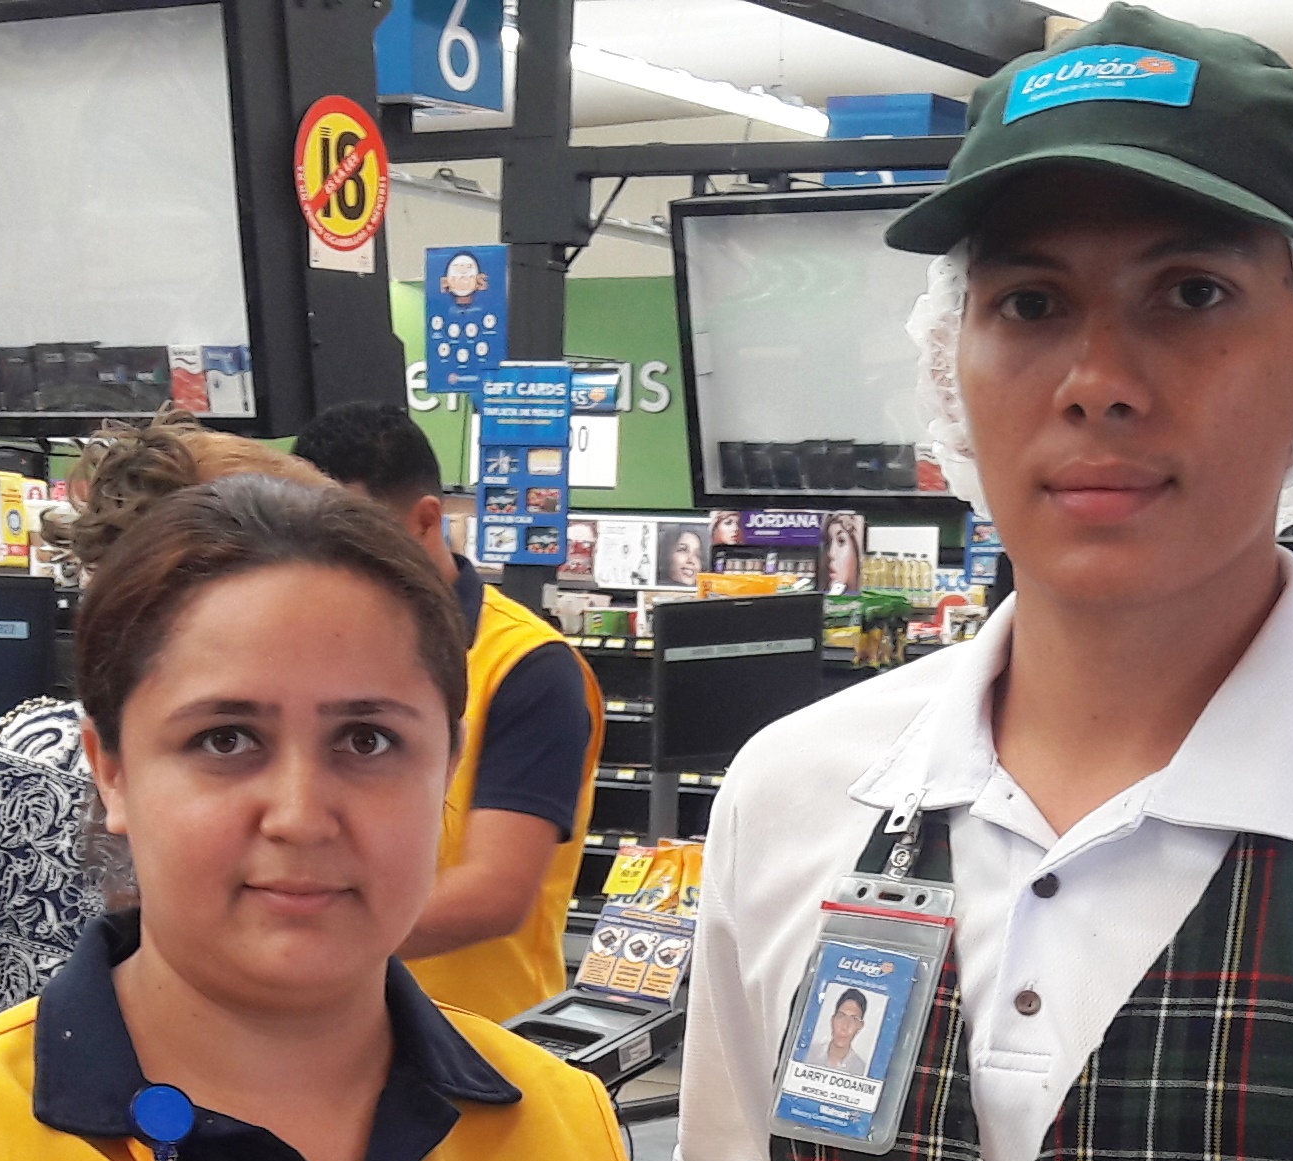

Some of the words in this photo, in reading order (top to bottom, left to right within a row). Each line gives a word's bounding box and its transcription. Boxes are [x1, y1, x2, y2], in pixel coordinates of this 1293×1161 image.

[438, 0, 480, 92] 6
[1022, 73, 1055, 95] La
[1056, 57, 1138, 82] Unión
[515, 382, 567, 397] CARDS
[746, 513, 821, 529] JORDANA
[793, 1066, 829, 1086] LARRY
